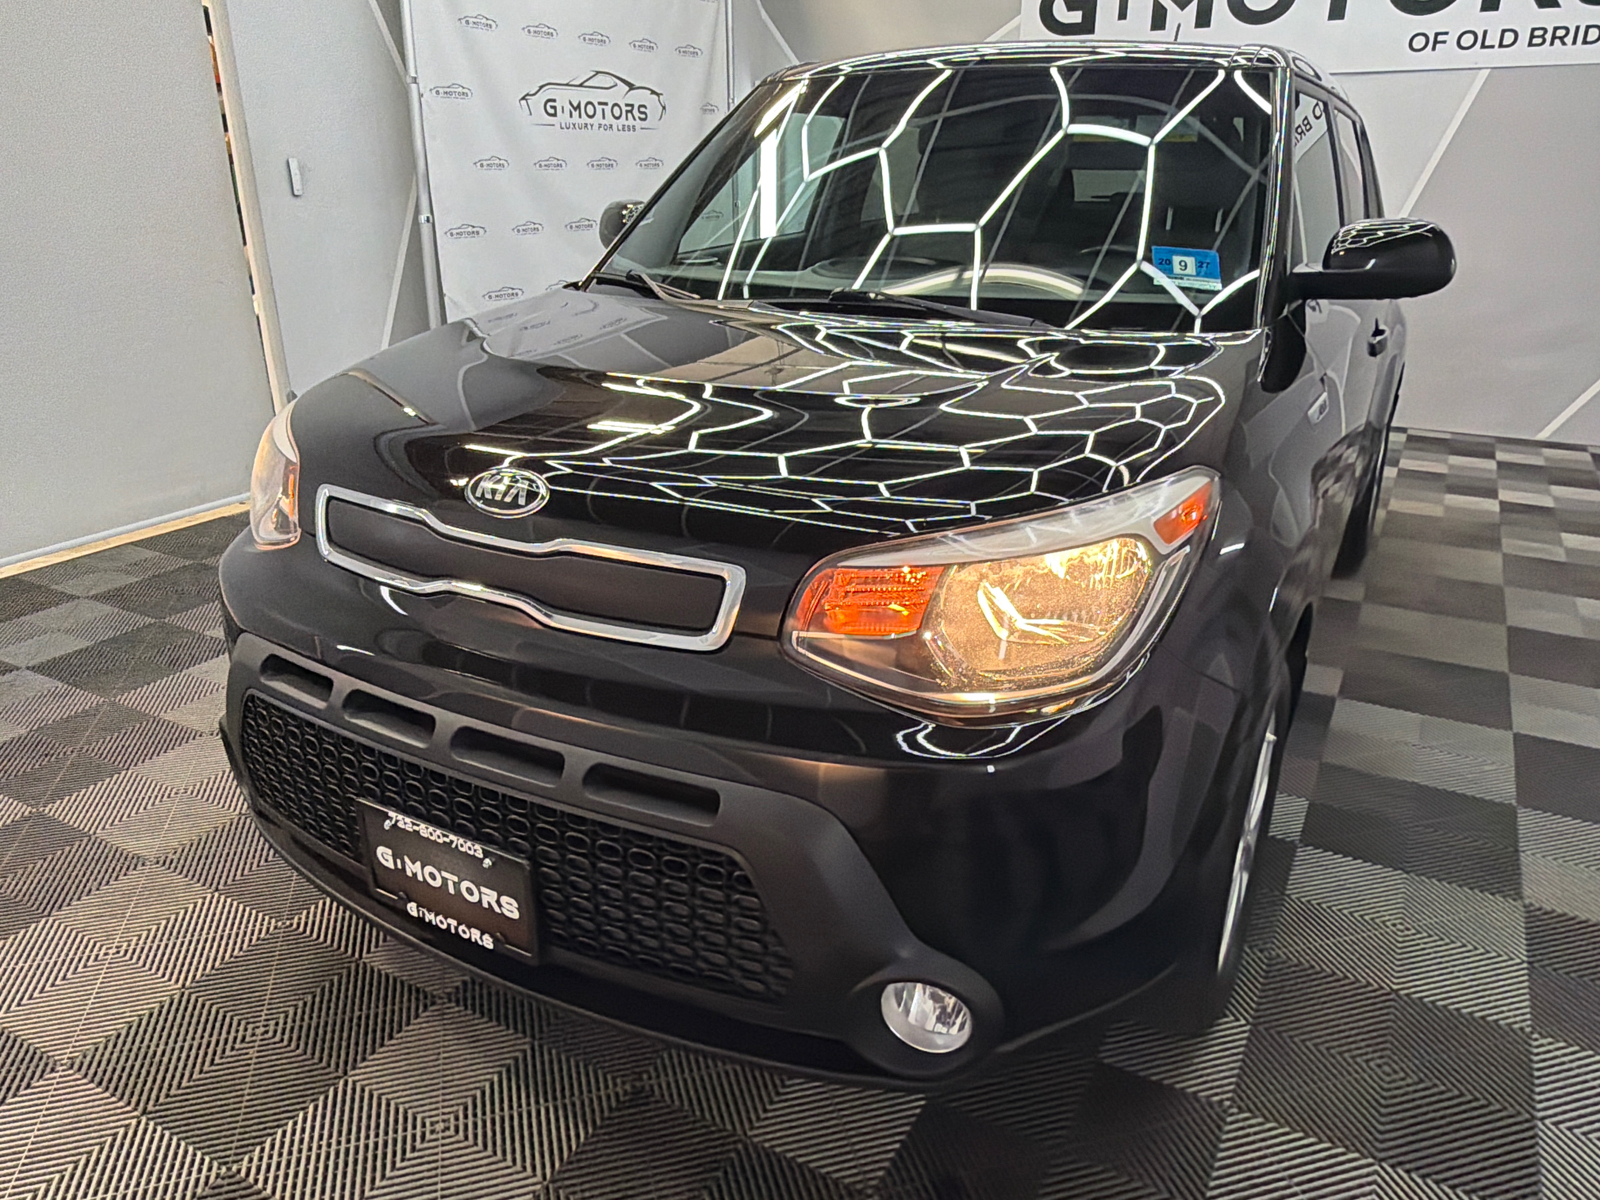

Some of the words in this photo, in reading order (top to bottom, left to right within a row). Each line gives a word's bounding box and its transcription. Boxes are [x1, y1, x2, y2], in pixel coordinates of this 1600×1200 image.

[1408, 31, 1449, 52] OF
[1456, 28, 1519, 50] OLD
[560, 122, 594, 130] LUXURY
[598, 123, 614, 131] FOR
[617, 124, 636, 132] LESS
[1158, 258, 1171, 266] 20
[1179, 260, 1188, 271] 9
[1198, 261, 1210, 269] 27
[475, 474, 529, 506] KIA
